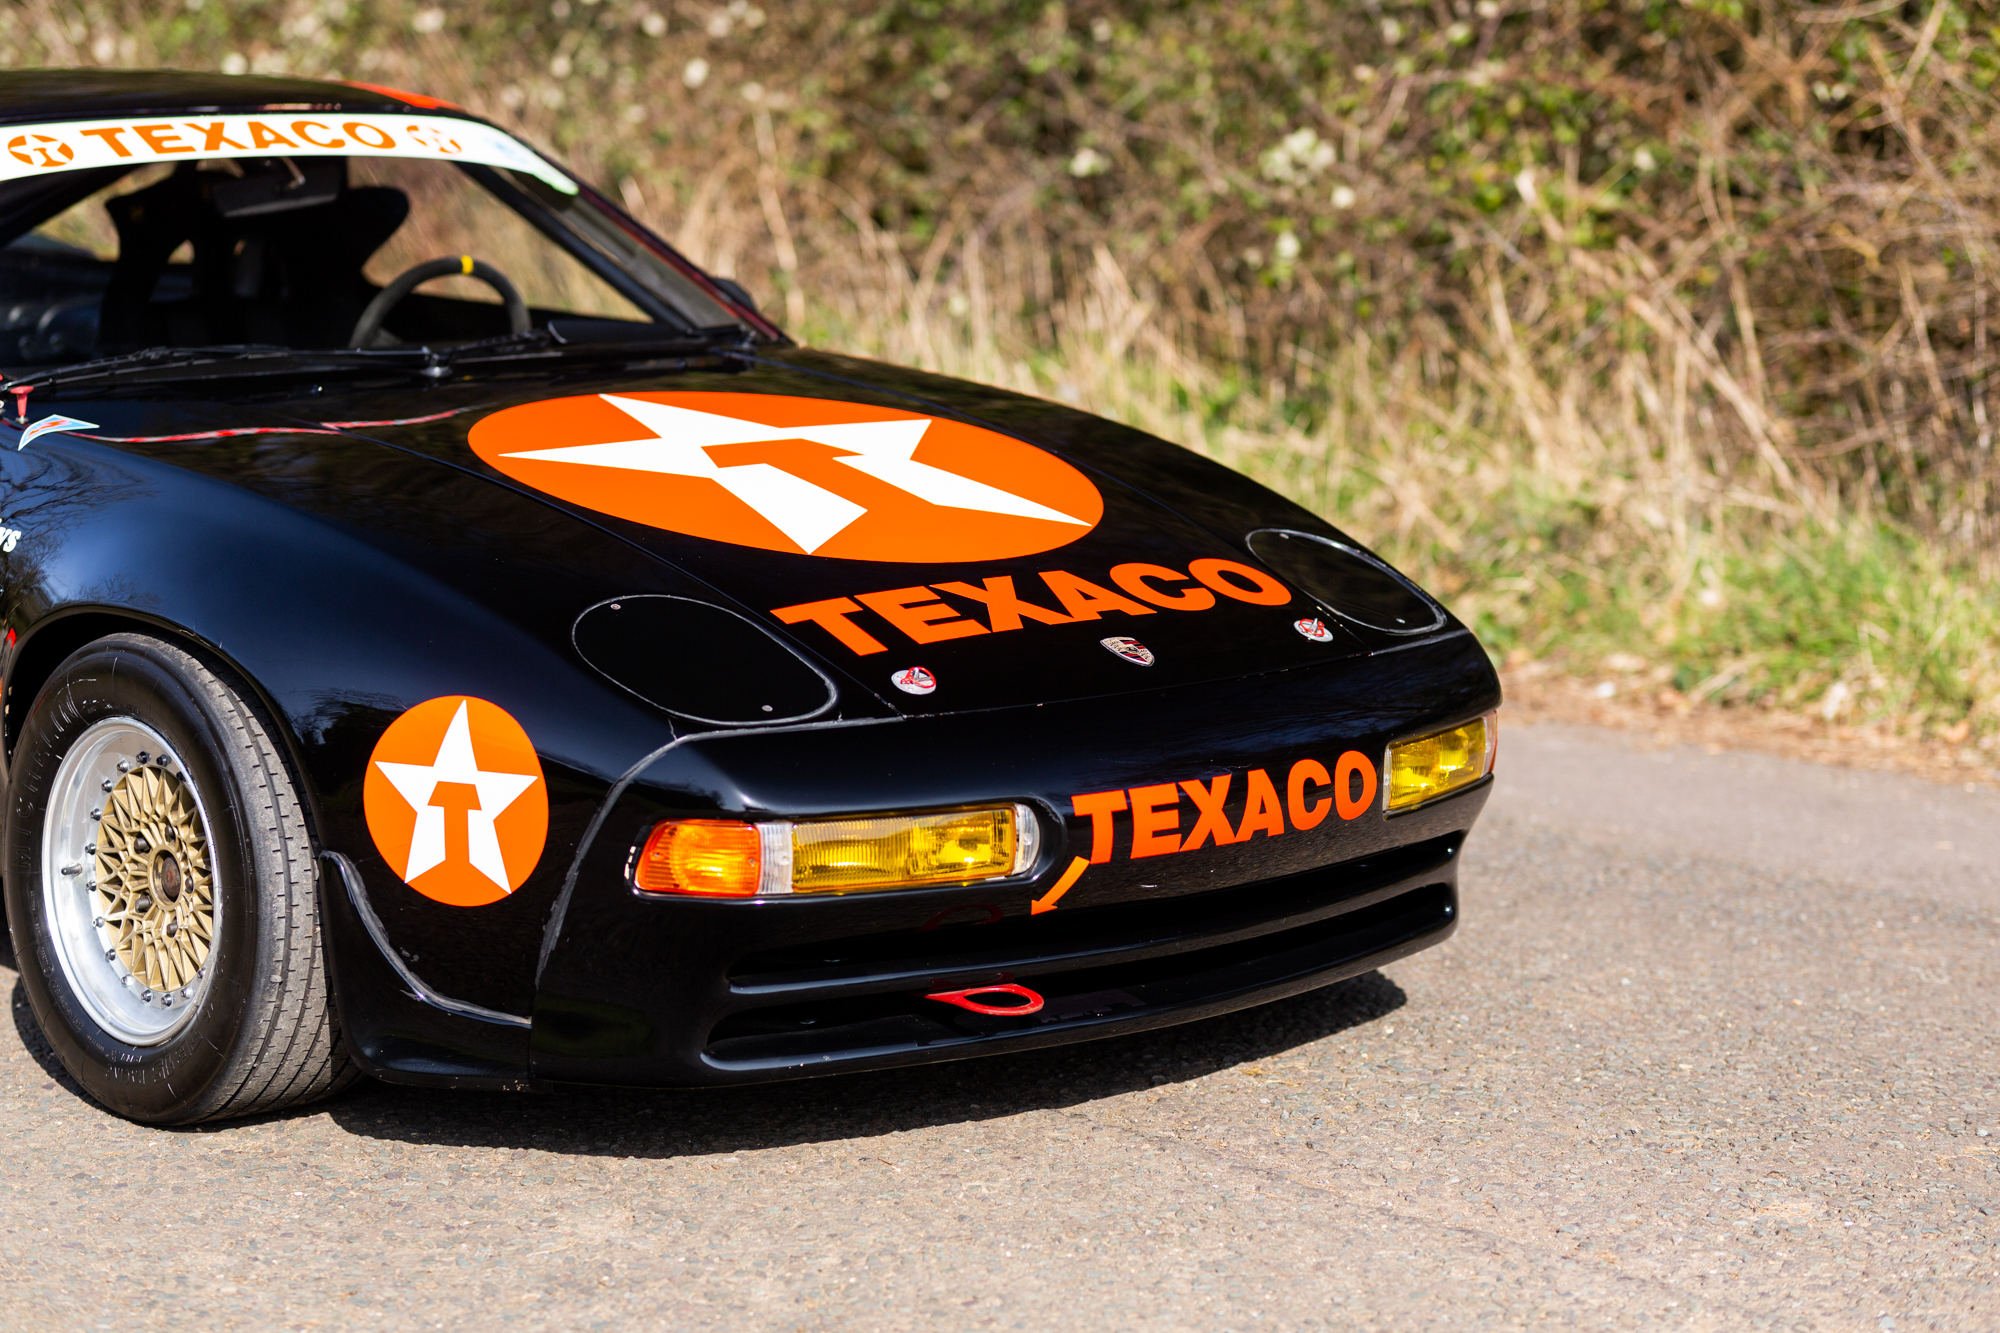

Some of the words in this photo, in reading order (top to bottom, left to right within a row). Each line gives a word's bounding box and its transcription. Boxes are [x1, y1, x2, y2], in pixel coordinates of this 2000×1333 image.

[81, 121, 396, 157] TEXACO
[769, 558, 1292, 657] TEXACO
[12, 691, 80, 870] MICHELIN
[1072, 750, 1378, 865] TEXACO
